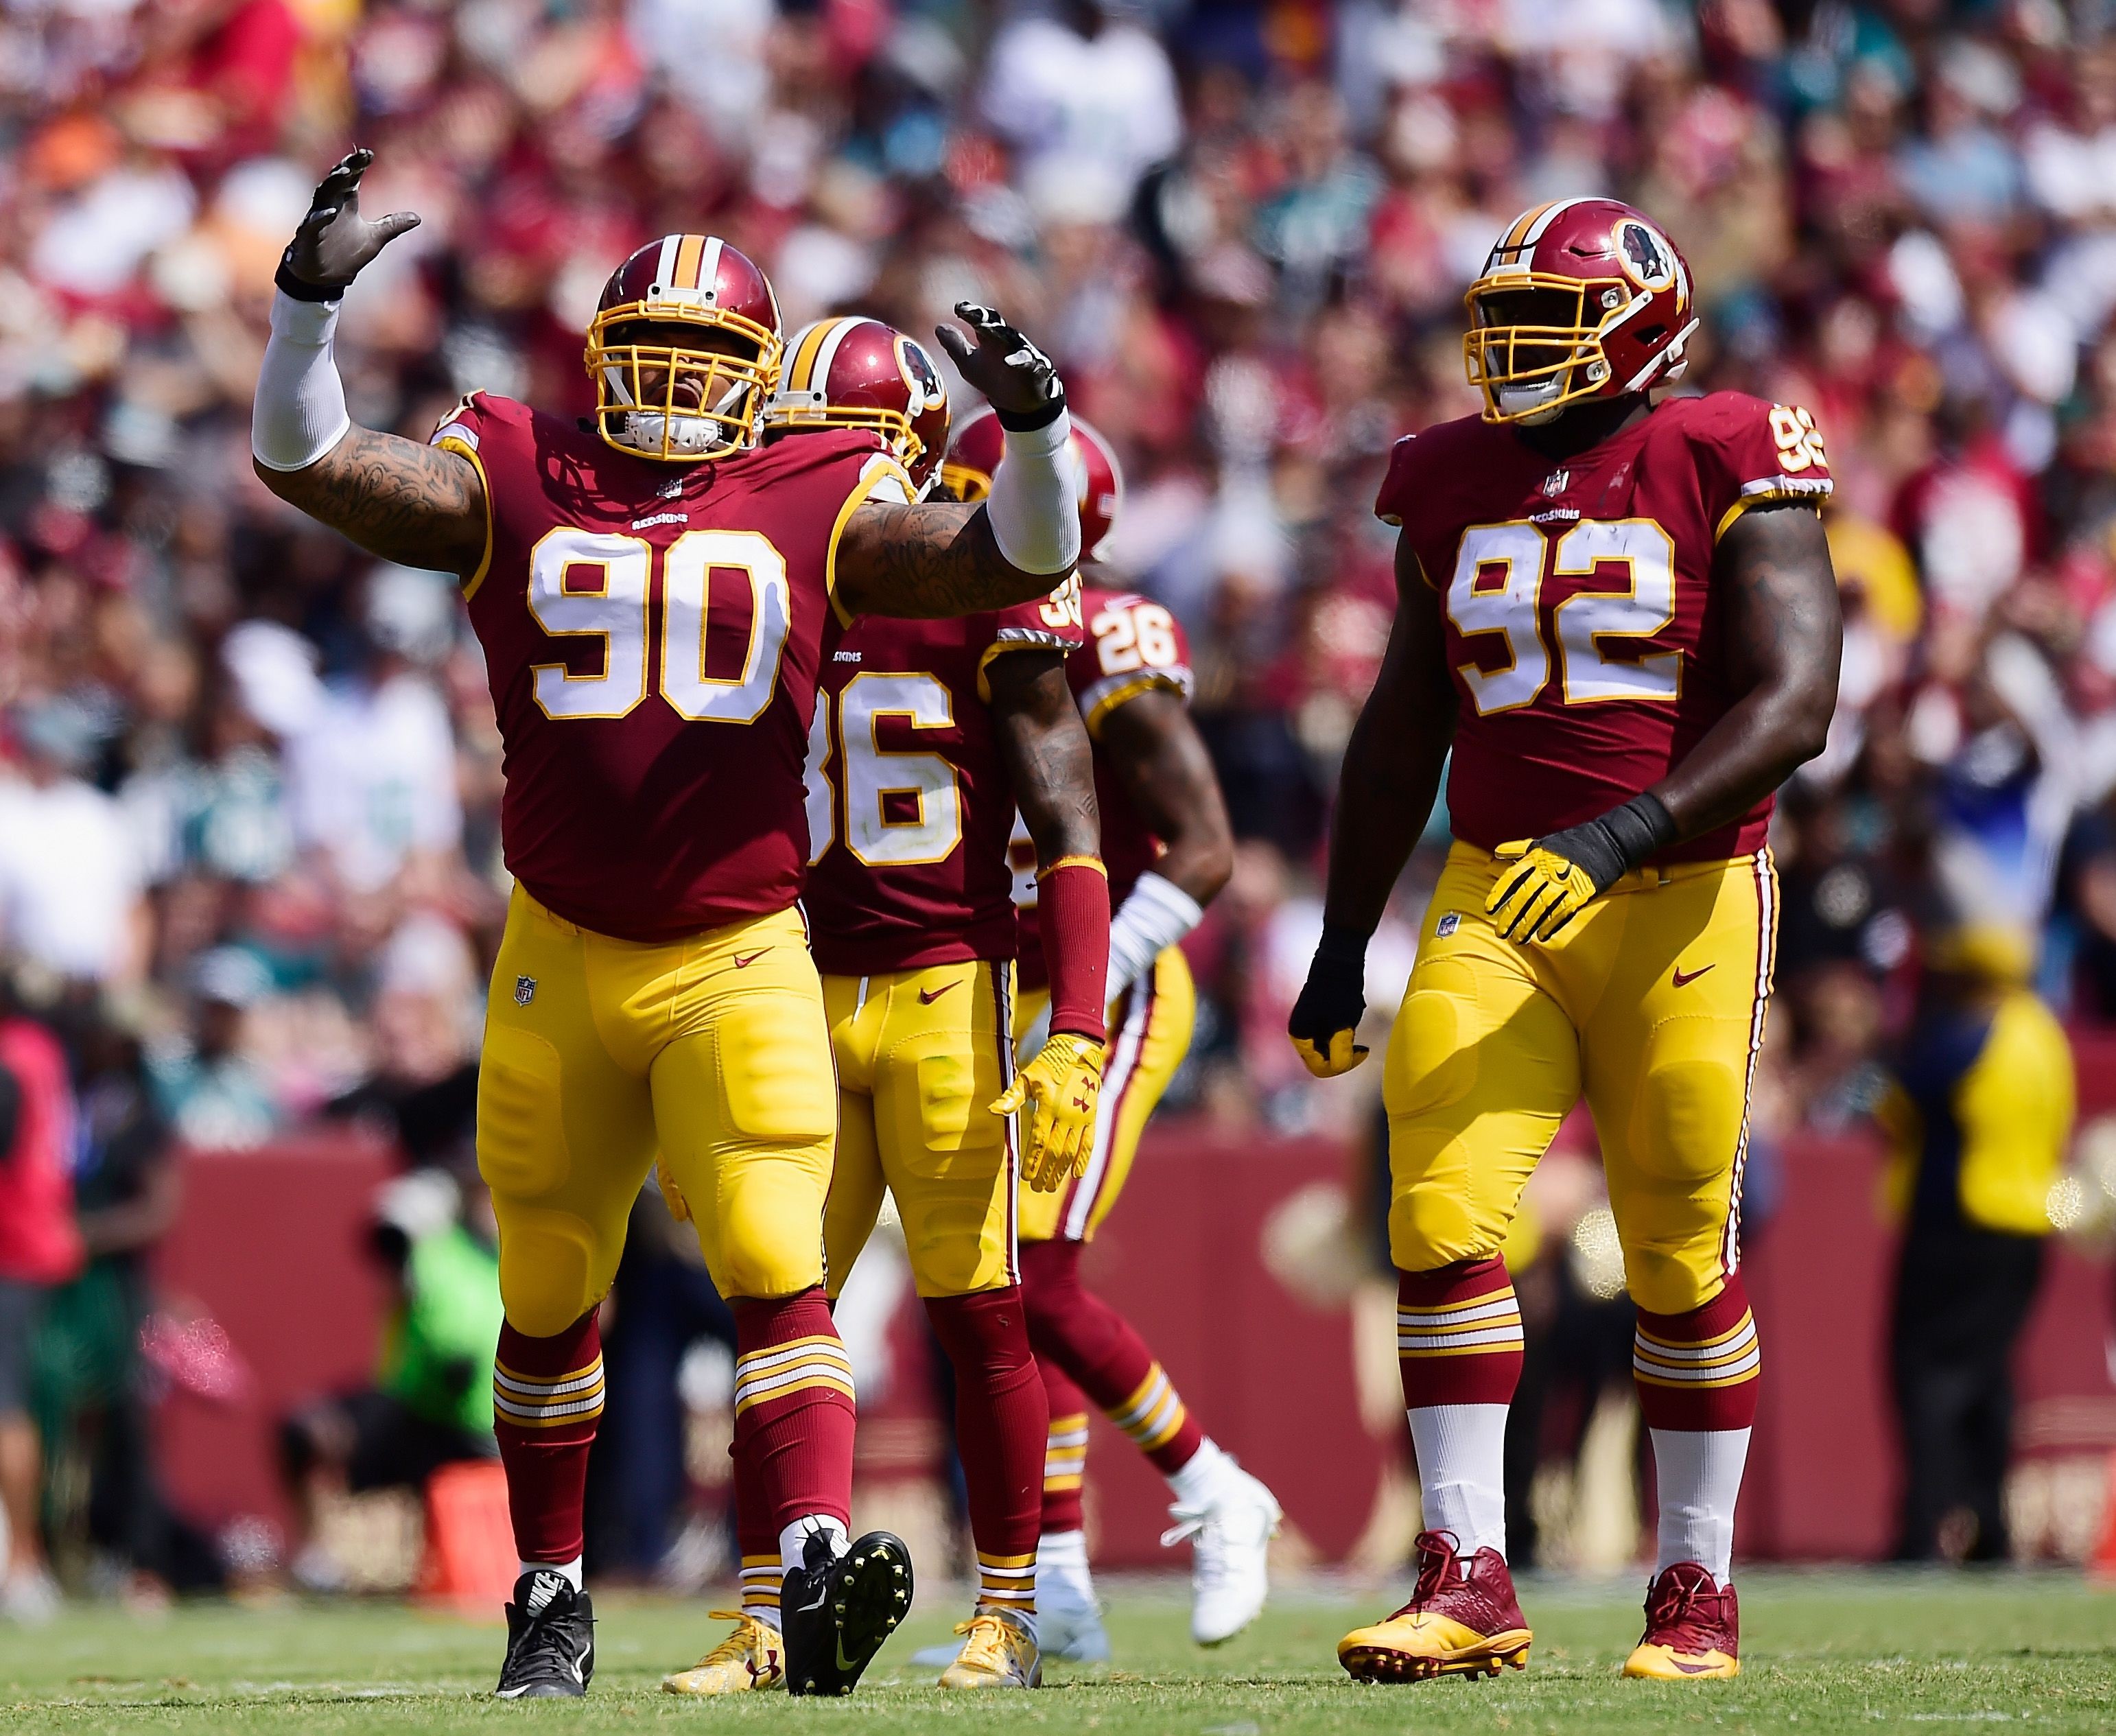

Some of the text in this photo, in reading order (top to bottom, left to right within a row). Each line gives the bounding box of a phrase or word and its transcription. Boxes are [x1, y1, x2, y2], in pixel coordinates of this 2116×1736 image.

[1769, 406, 1829, 472] 92
[632, 513, 688, 530] REDSKINS
[527, 526, 790, 725] 90
[1091, 604, 1177, 677] 26
[1447, 518, 1683, 716] 92
[526, 1572, 559, 1617] NIKE
